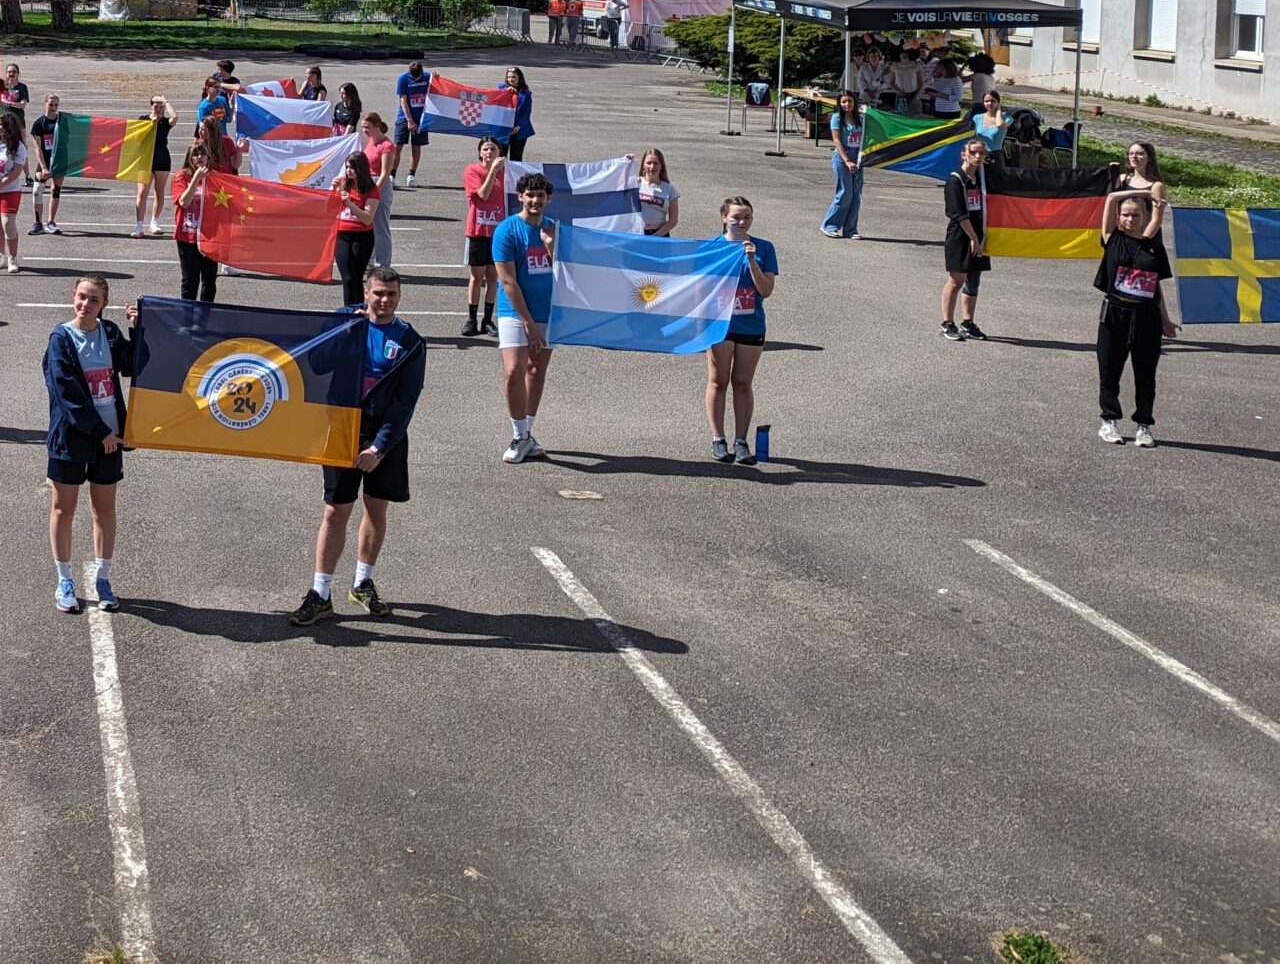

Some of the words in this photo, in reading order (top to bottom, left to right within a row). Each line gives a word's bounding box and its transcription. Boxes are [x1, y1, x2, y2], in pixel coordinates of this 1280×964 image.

[891, 12, 906, 23] JE
[907, 12, 937, 23] VOIS
[937, 12, 952, 22] LA
[952, 11, 973, 22] VIE
[988, 12, 1040, 22] VOSGES
[476, 210, 496, 220] ELA
[527, 255, 549, 268] ELA
[1117, 273, 1142, 290] ELA
[233, 397, 257, 414] 24
